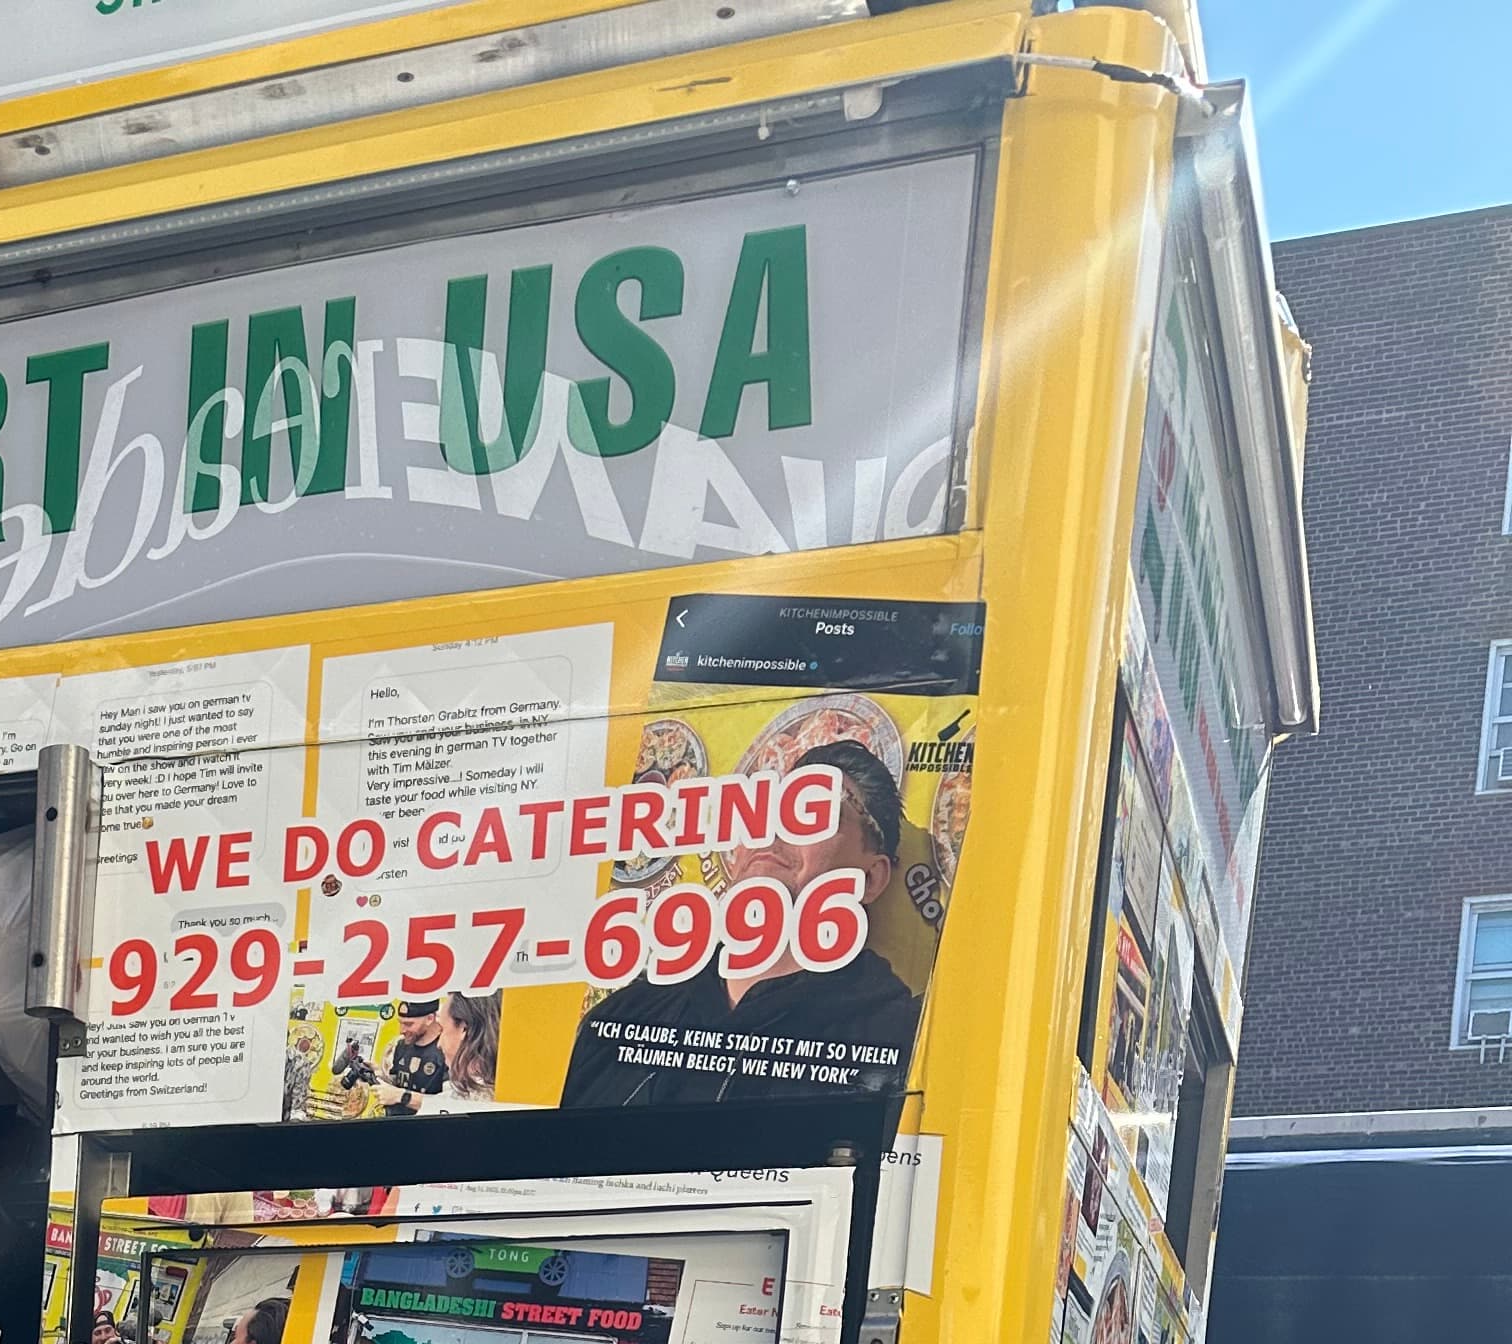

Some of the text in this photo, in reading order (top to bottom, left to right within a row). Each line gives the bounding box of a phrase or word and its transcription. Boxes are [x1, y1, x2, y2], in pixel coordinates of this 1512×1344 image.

[182, 296, 358, 514] IN
[438, 223, 813, 478] USA
[779, 607, 899, 623] KITCHENIMPOSSIBLE
[815, 621, 855, 636] Posts
[697, 656, 807, 671] kitchenimpossible
[370, 687, 400, 699] Hello,
[101, 710, 118, 721] Hey
[121, 708, 141, 718] Man
[147, 705, 166, 714] saw
[169, 702, 186, 713] you
[188, 701, 200, 709] on
[202, 695, 239, 709] german
[243, 694, 251, 703] tv
[368, 716, 385, 729] I'm
[388, 713, 435, 728] Thorsten
[480, 705, 507, 717] from
[908, 741, 974, 764] KITCHEN
[905, 762, 973, 773] IMPOSSIBLE
[145, 772, 834, 896] WE DO CATERING
[108, 877, 860, 1016] 929-257-6996
[624, 1023, 680, 1046] GLAUBE,
[683, 1029, 723, 1049] KEINE
[725, 1033, 769, 1054] STADT
[771, 1037, 793, 1055] IST
[796, 1039, 823, 1058] MIT
[826, 1042, 847, 1060] SO
[851, 1044, 899, 1066] VIELEN
[617, 1044, 684, 1068] TRÄUMEN
[687, 1056, 738, 1076] BELEGT,
[742, 1058, 768, 1077] WIE
[772, 1061, 806, 1080] NEW
[489, 1247, 530, 1263] TONG
[360, 1288, 642, 1331] BANGLADESHI STREET FOOD
